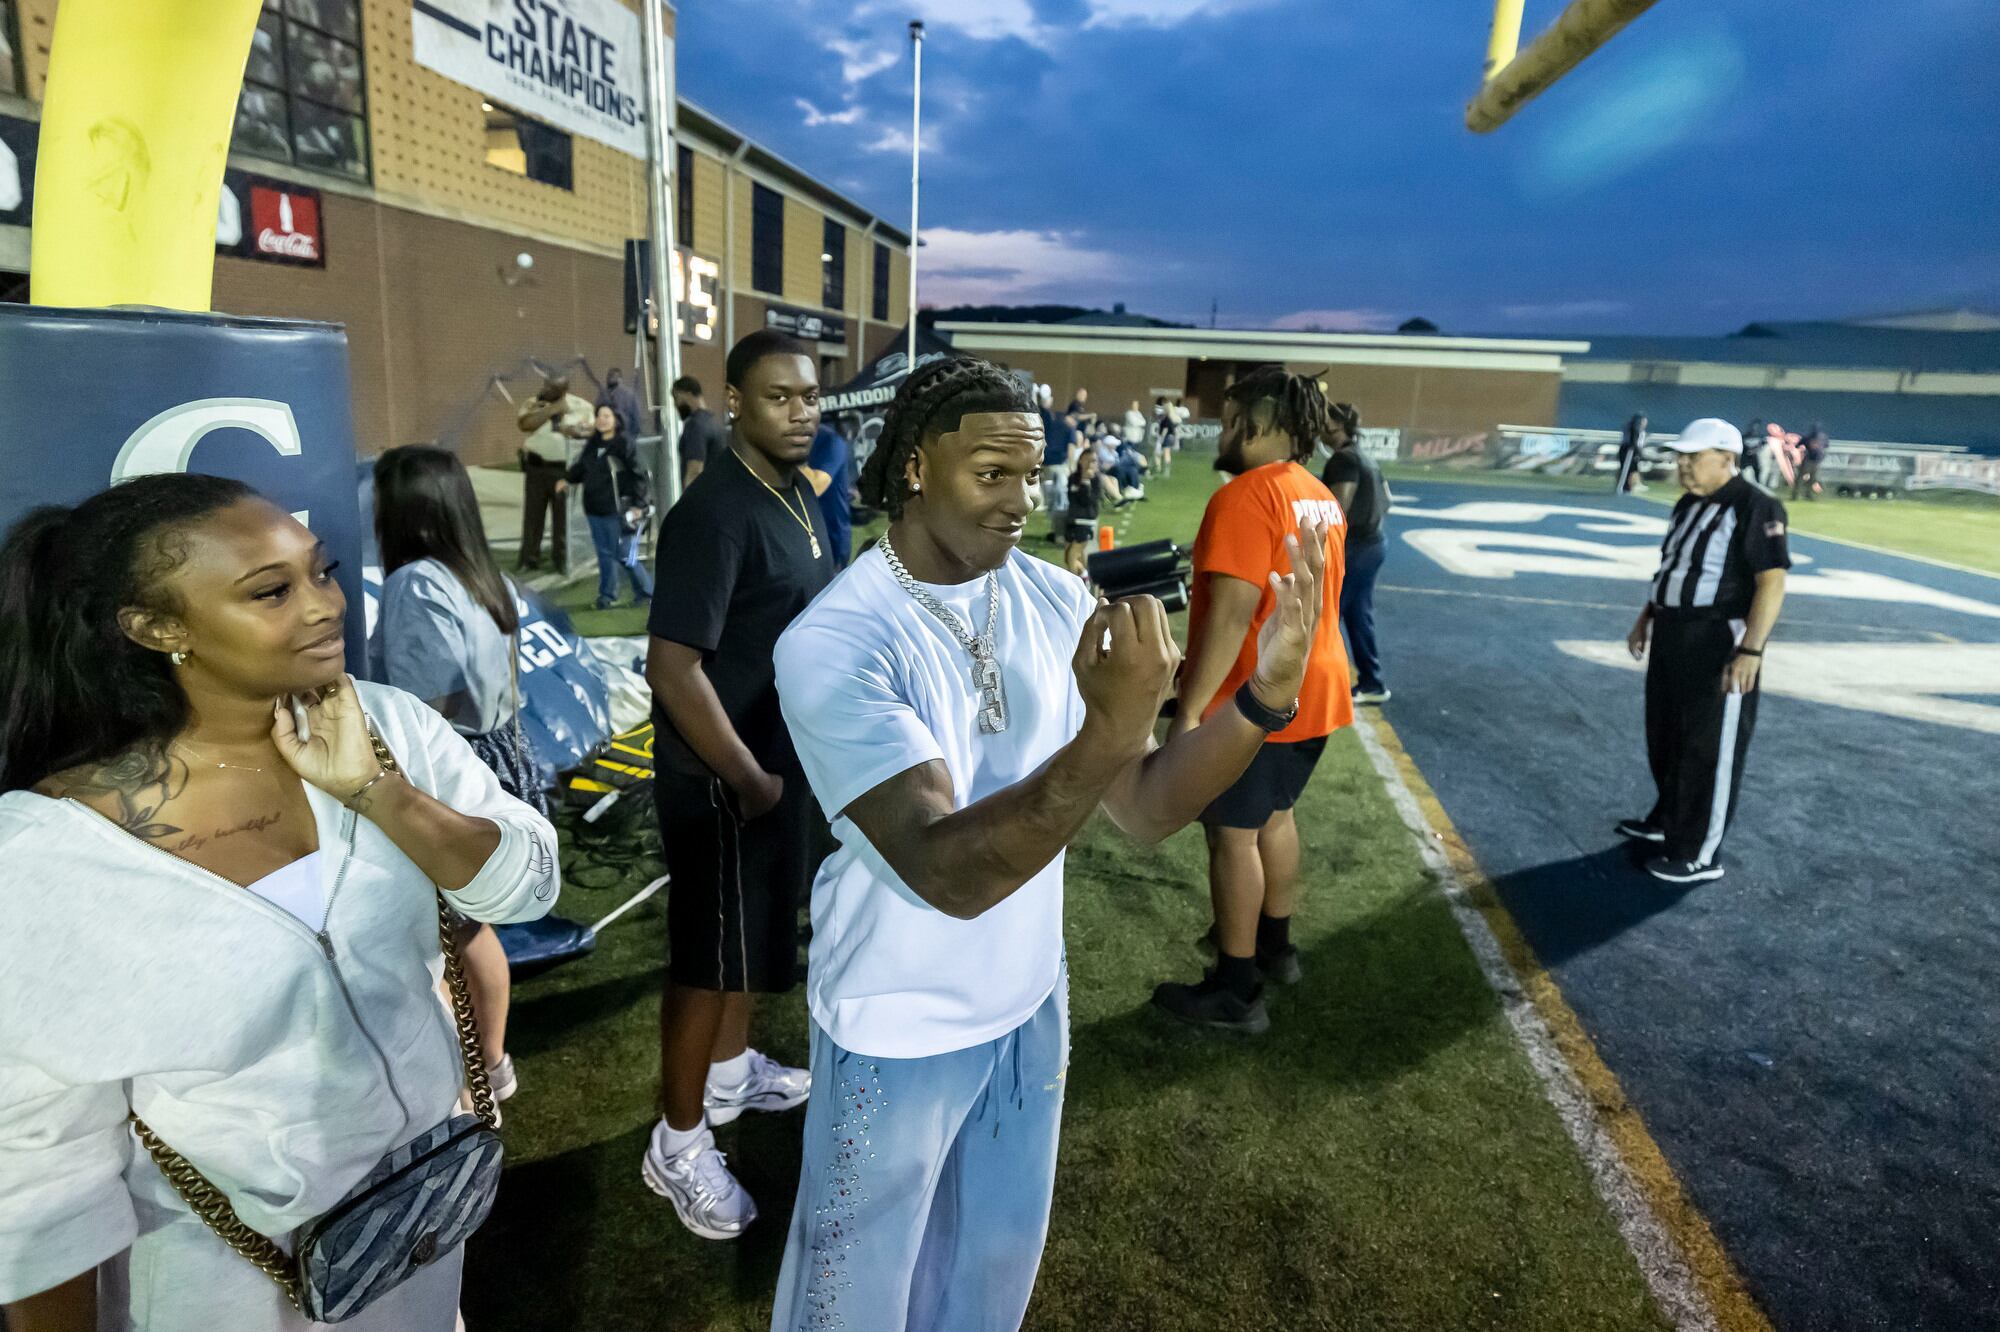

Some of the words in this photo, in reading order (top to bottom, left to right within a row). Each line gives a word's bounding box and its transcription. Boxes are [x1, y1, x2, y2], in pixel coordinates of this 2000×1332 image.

[486, 20, 636, 127] CHAMPIONS
[514, 0, 616, 85] STATE
[818, 385, 897, 412] BRANDON
